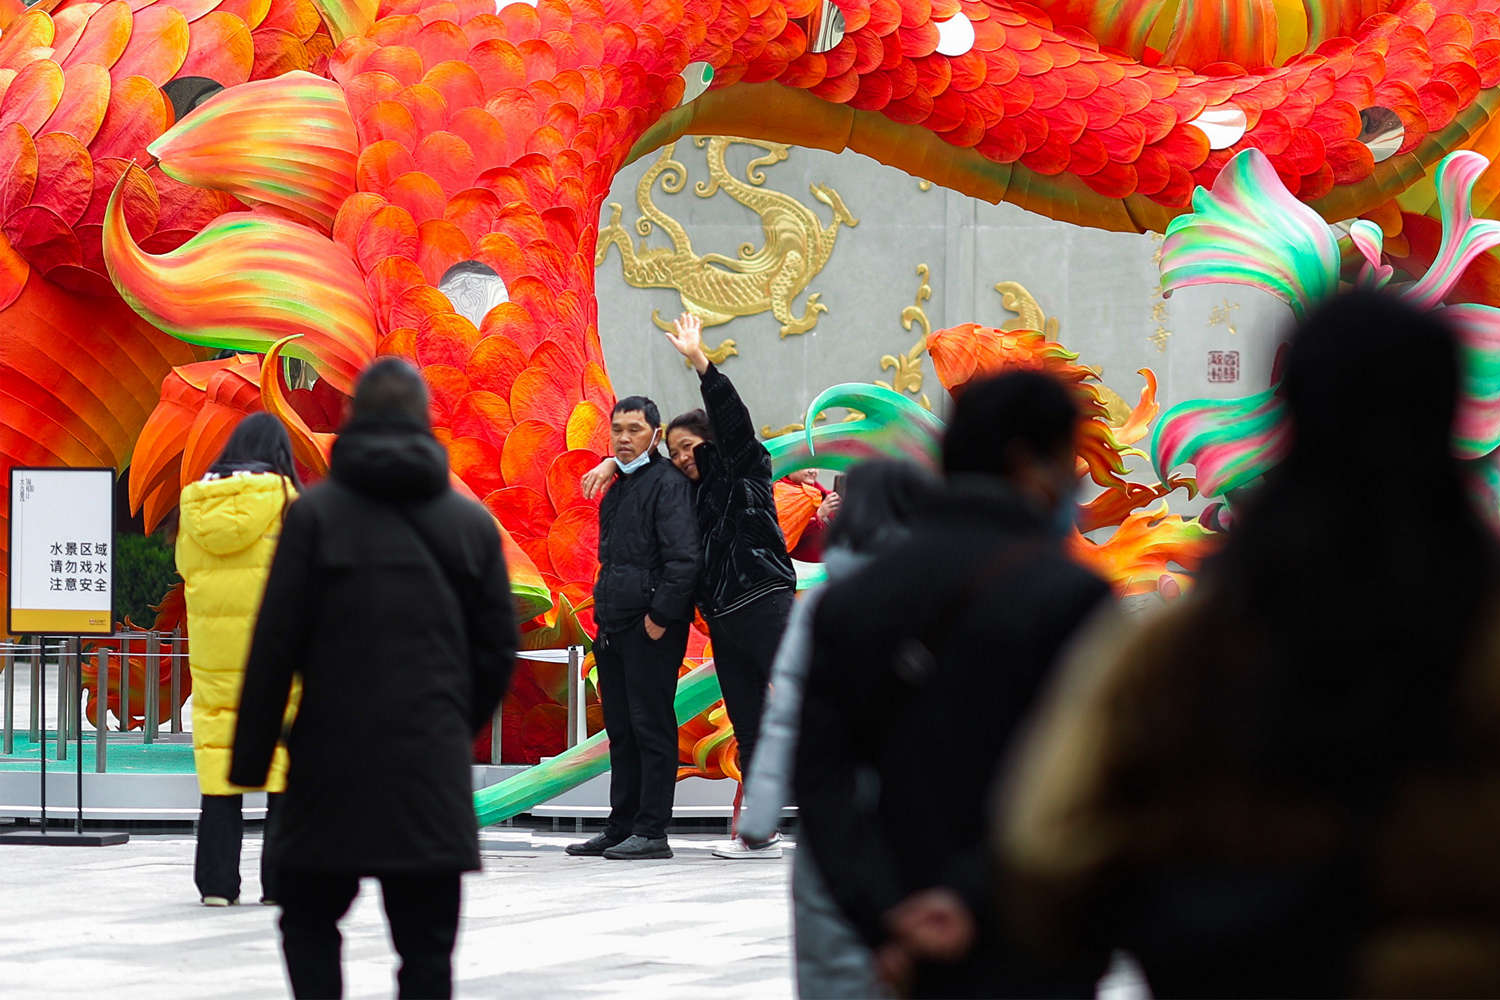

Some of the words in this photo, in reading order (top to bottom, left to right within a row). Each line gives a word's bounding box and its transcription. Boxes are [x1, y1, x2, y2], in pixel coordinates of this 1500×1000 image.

[50, 541, 108, 556] 水景区域
[50, 560, 108, 574] 请勿戏水
[50, 577, 108, 592] 注意安全
